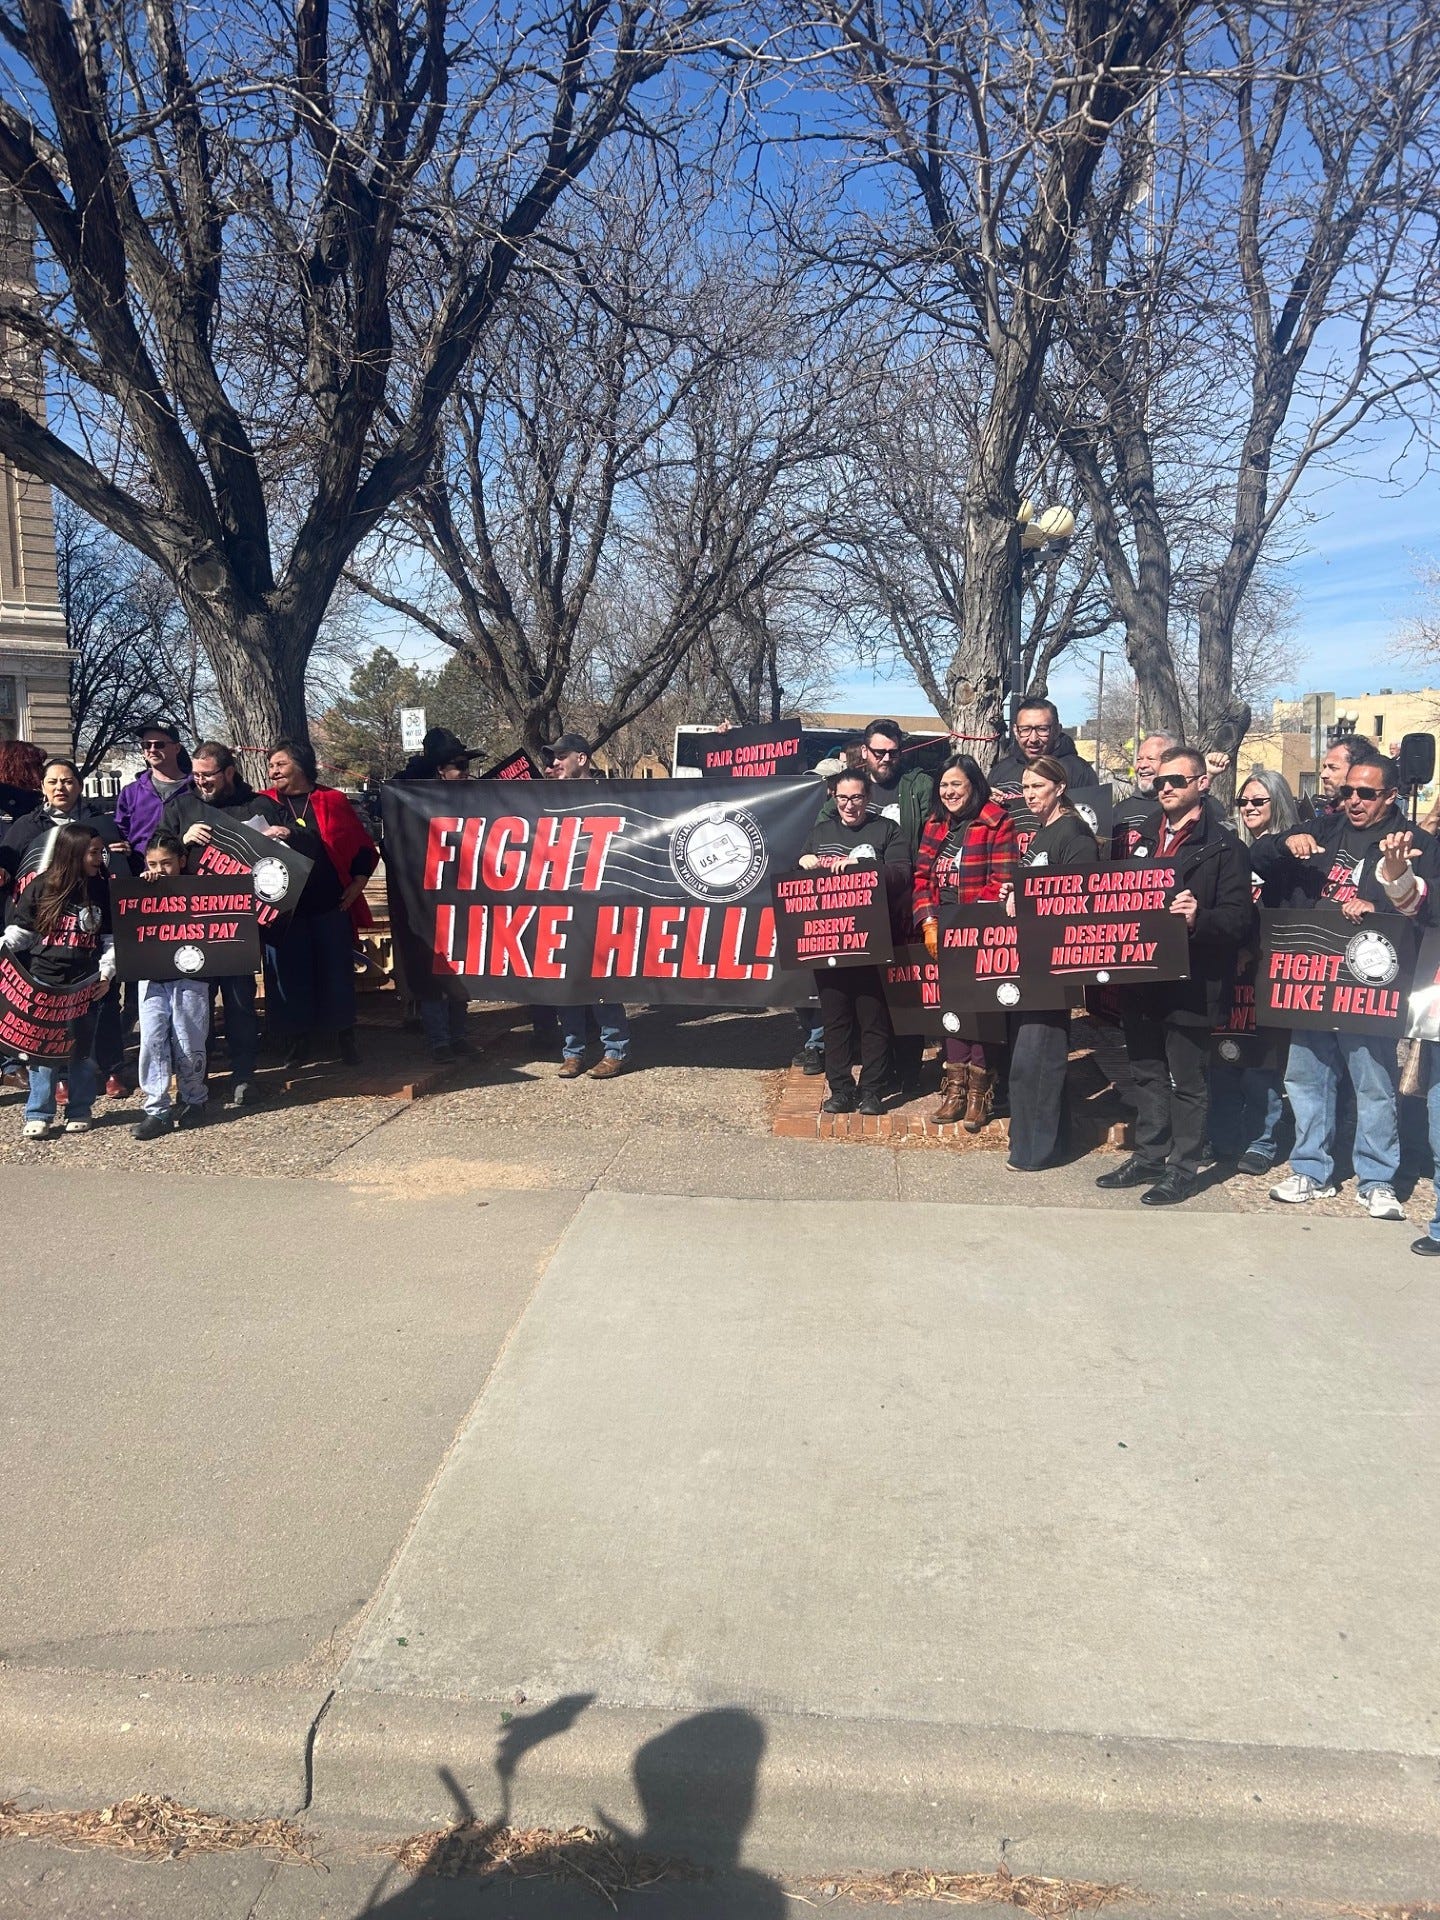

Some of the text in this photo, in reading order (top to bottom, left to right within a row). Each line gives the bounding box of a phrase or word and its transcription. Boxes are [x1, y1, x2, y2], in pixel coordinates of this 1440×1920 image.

[706, 738, 800, 768] FAIR CONTRACT
[734, 813, 762, 850] OF LETTER
[423, 816, 626, 892] FIGHT
[679, 864, 709, 893] NATIONAL
[735, 855, 762, 890] CARRIERS
[777, 871, 879, 898] LETTER CARRIERS
[1024, 868, 1176, 897] LETTER CARRIERS
[140, 896, 187, 914] CLASS
[190, 894, 252, 911] SERVICE
[784, 889, 873, 914] WORK HARDER
[1036, 890, 1166, 916] WORK HARDER
[158, 924, 205, 940] CLASS
[208, 922, 239, 938] PAY
[804, 916, 856, 936] DESERVE
[943, 928, 979, 948] FAIR
[1064, 922, 1141, 945] DESERVE
[432, 904, 775, 981] LIKE HELL!
[797, 932, 869, 953] HIGHER PAY
[1051, 942, 1158, 966] HIGHER PAY
[0, 958, 34, 999] LETTER
[887, 964, 922, 983] FAIR
[1269, 953, 1345, 983] FIGHT
[0, 977, 34, 1014] WORK
[1270, 983, 1327, 1012] LIKE
[1332, 985, 1400, 1018] HELL!
[0, 1022, 76, 1054] IGHER PAY
[3, 1010, 69, 1041] DESERVE
